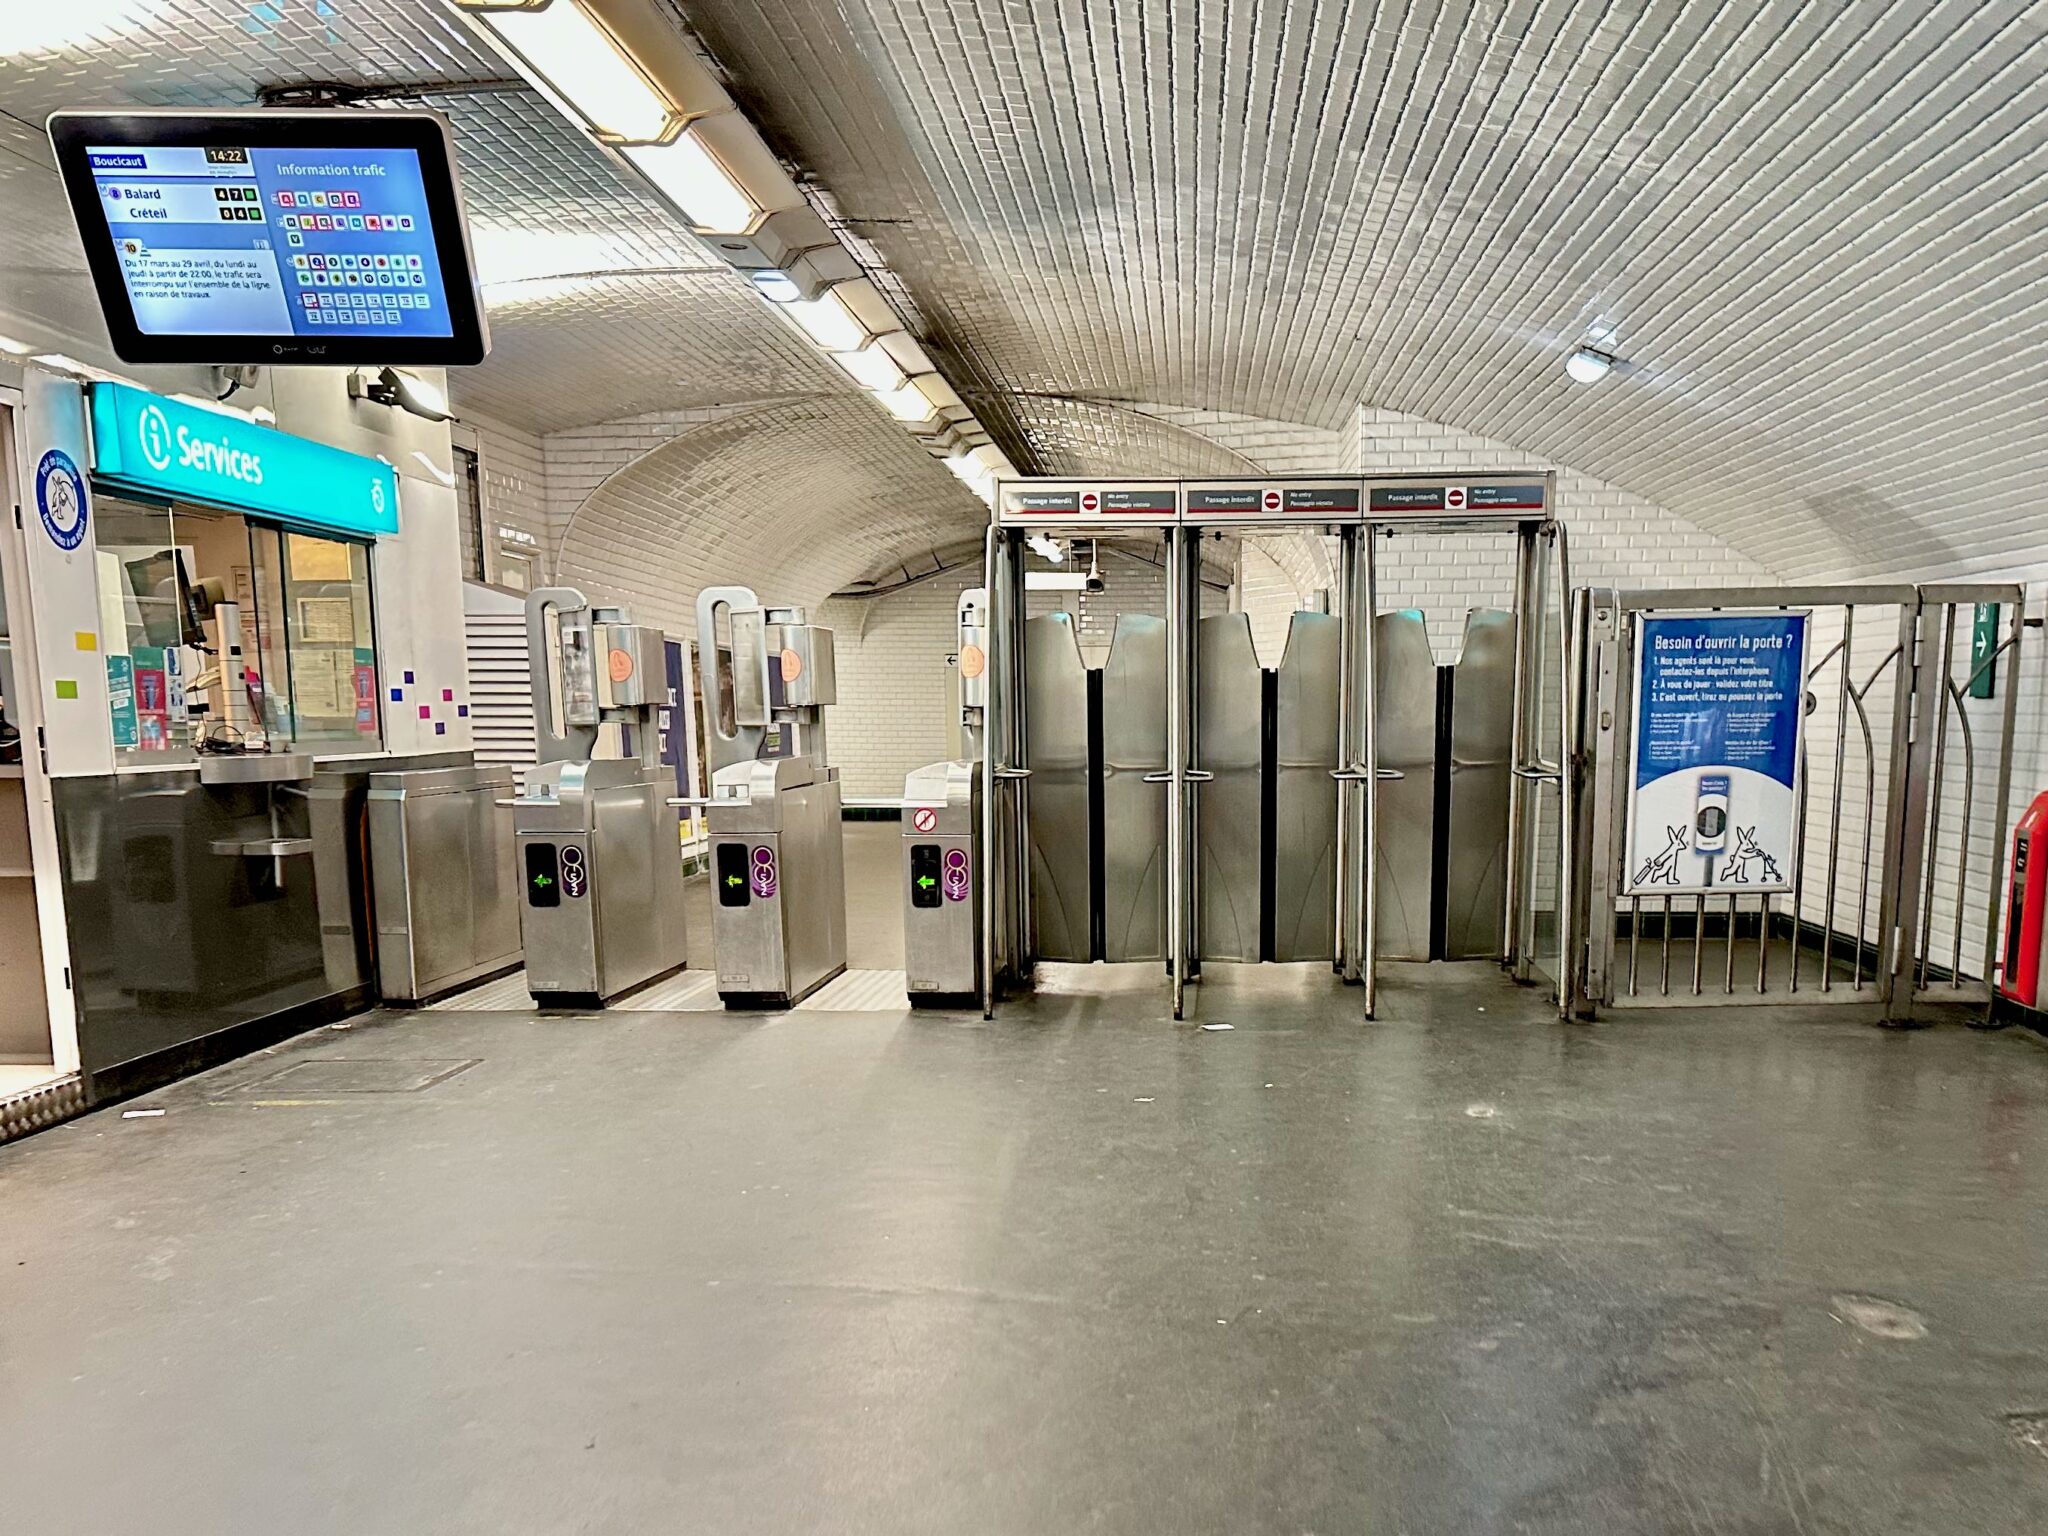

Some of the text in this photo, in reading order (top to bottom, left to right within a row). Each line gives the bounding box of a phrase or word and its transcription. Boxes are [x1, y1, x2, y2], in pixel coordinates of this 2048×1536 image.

[94, 156, 142, 166] Boucicaut
[210, 151, 242, 162] 14:22
[277, 164, 386, 176] Information trafic
[124, 189, 161, 200] Balard
[130, 208, 168, 219] Créteil
[128, 270, 146, 279] jeudi
[156, 270, 176, 279] partir
[131, 280, 174, 289] interrompu
[252, 281, 270, 290] ligne
[176, 425, 264, 486] Services
[1022, 497, 1048, 505] Passage
[1388, 494, 1414, 502] Passage
[1655, 634, 1793, 652] Besoin d'ouvrir la porte ?
[1660, 656, 1673, 665] Nos
[1674, 656, 1697, 666] agents
[1698, 656, 1713, 665] sont
[1714, 656, 1721, 664] là
[1722, 657, 1738, 666] pour
[1660, 667, 1769, 677] contactez-les depuis l'interphone
[1652, 680, 1659, 688] 2.
[1660, 678, 1666, 688] À
[1683, 680, 1692, 688] de
[1693, 680, 1711, 690] jouer
[1716, 680, 1739, 688] validez
[1740, 680, 1757, 688] votre
[1759, 680, 1774, 688] titre
[1652, 693, 1658, 702] 3.
[1659, 692, 1676, 701] C'est
[1677, 692, 1700, 702] ouvert,
[1701, 692, 1717, 701] tirez
[1728, 693, 1755, 702] poussez
[1756, 692, 1764, 700] la
[1764, 692, 1783, 702] porte
